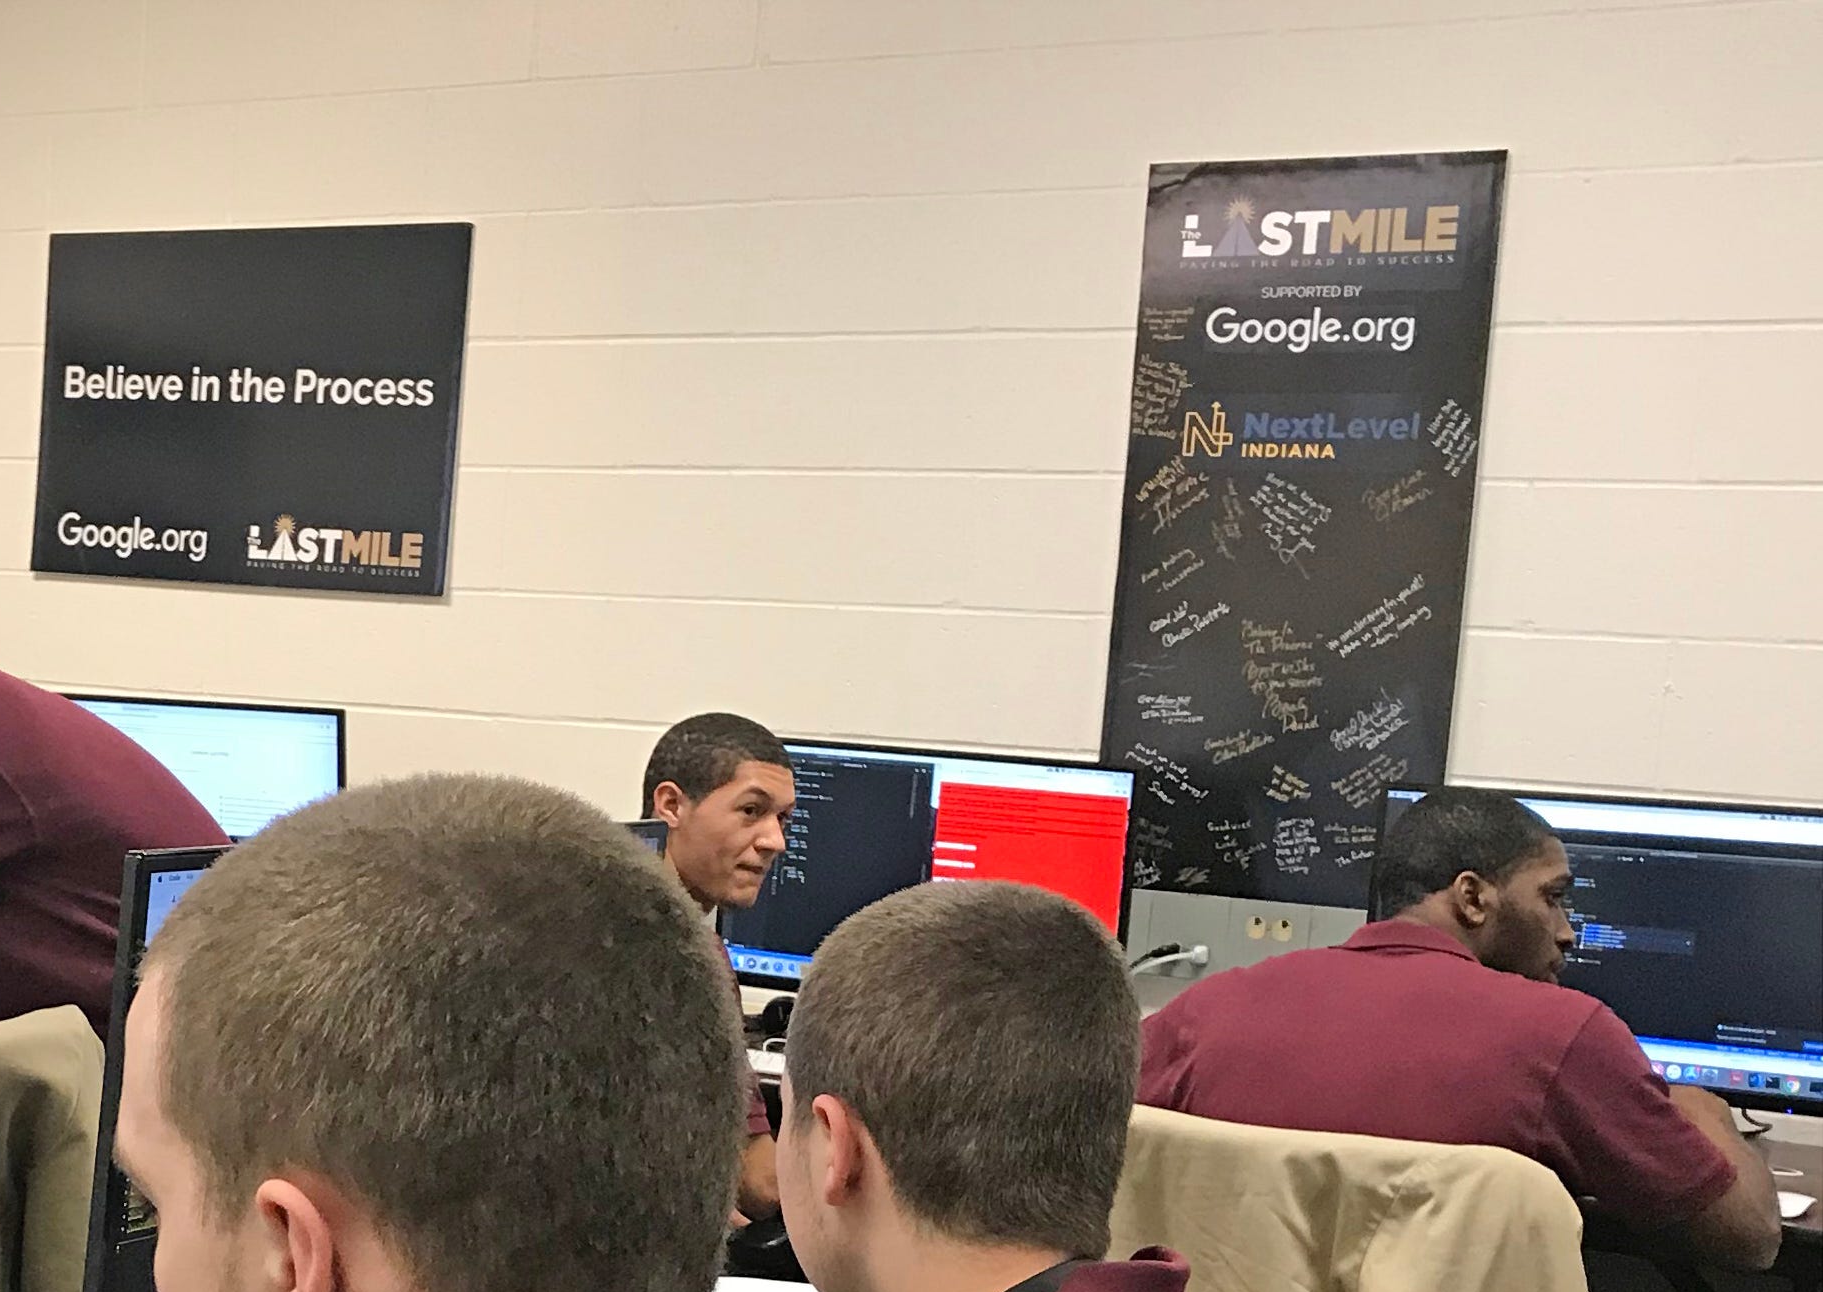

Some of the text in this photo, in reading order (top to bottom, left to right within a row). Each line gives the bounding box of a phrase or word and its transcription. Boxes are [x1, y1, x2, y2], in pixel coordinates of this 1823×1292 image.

[1181, 230, 1201, 239] The
[1179, 255, 1455, 269] PAVING THE ROAD TO SUCCESS
[1261, 285, 1362, 298] SUPPORTED BY
[1205, 307, 1415, 353] Google.org
[64, 365, 434, 406] Believe in the Process
[1243, 412, 1420, 441] NextLevel
[1241, 443, 1335, 459] INDIANA
[57, 512, 207, 562] Google.org
[246, 561, 284, 569] PAVING
[371, 568, 419, 577] SUCCESS
